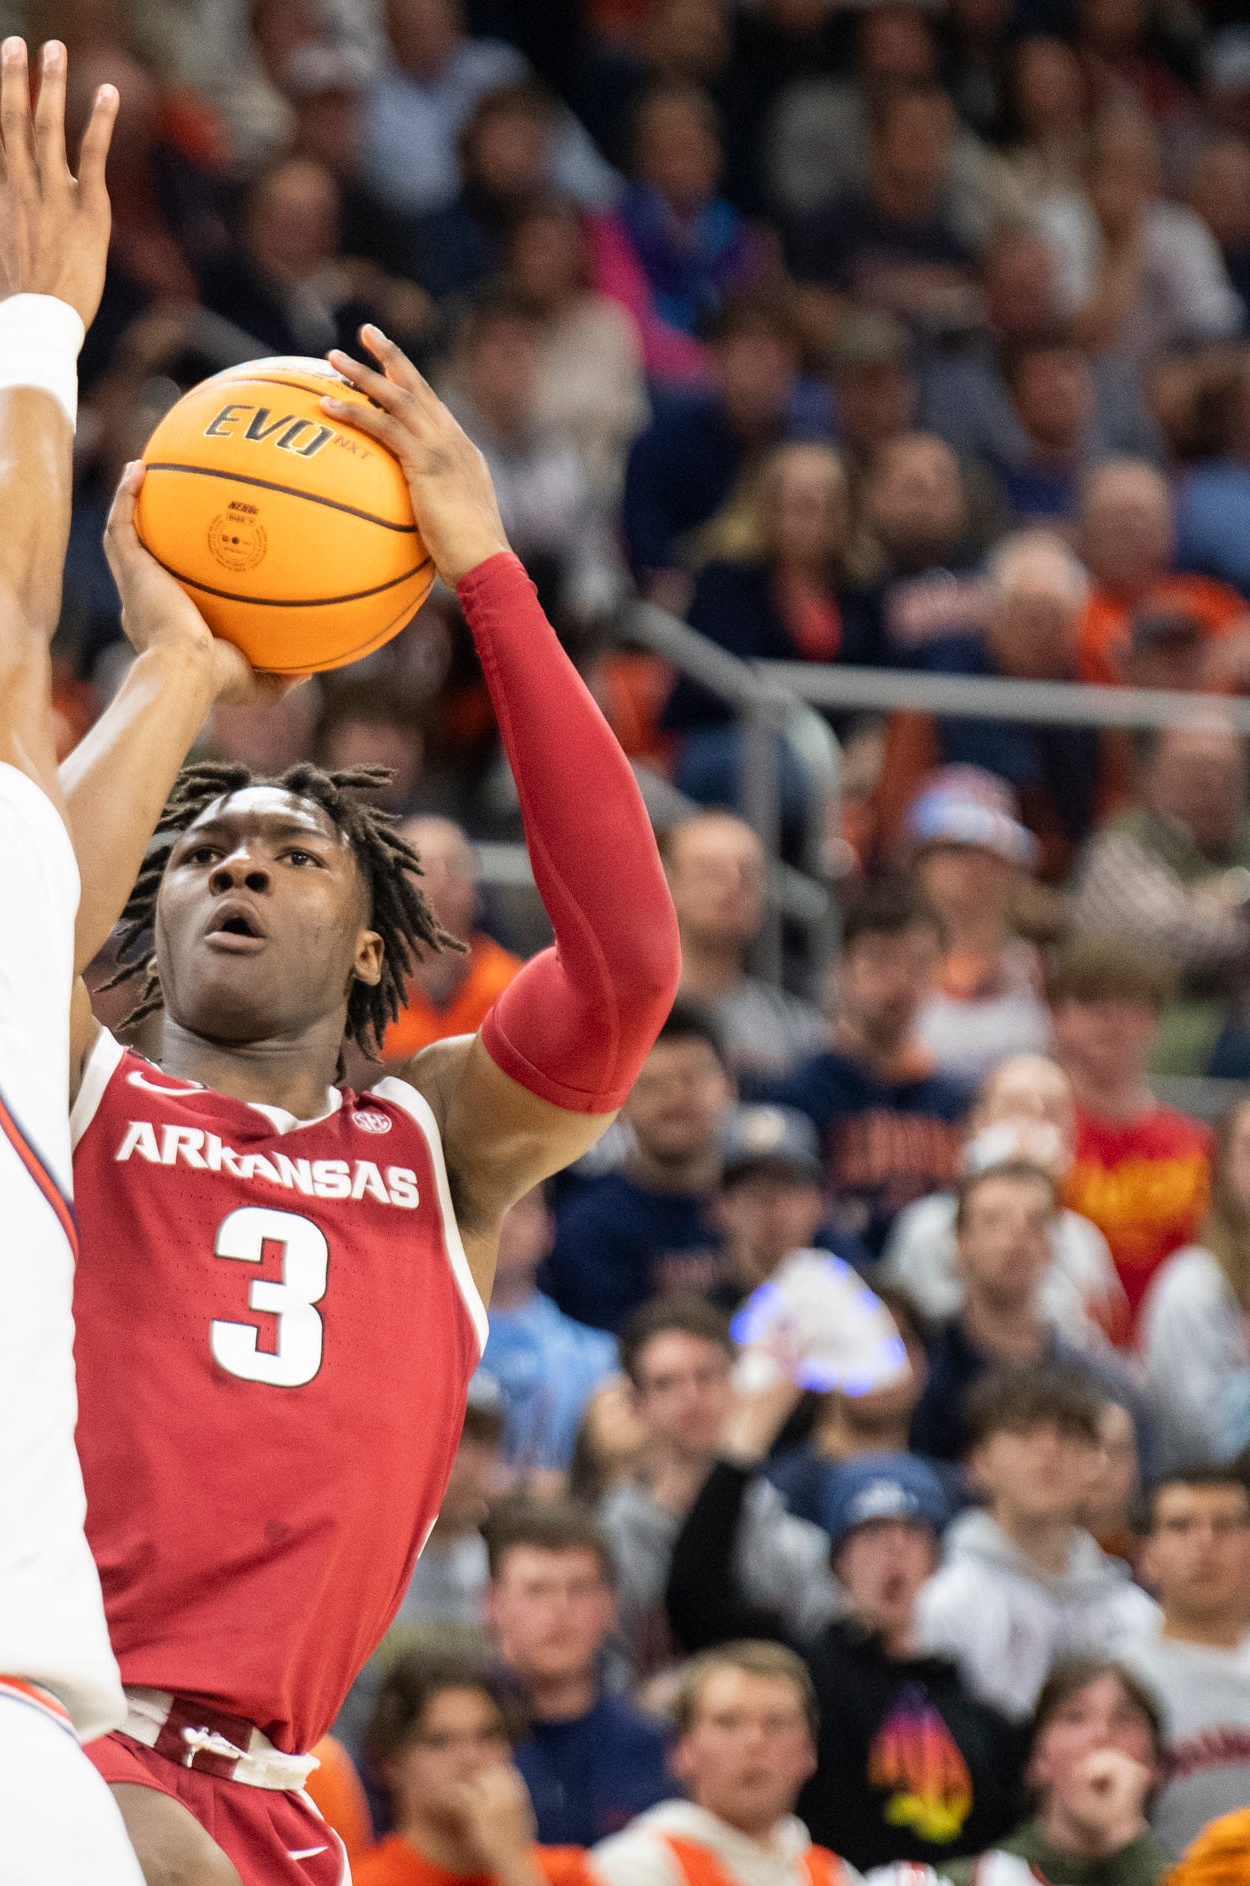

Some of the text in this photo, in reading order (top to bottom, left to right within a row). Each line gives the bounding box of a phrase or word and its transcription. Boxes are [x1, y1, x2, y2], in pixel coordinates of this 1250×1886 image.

[203, 403, 374, 461] EVO NXT
[354, 1112, 390, 1132] SEC
[115, 1120, 421, 1210] ARKANSAS
[209, 1205, 329, 1389] 3
